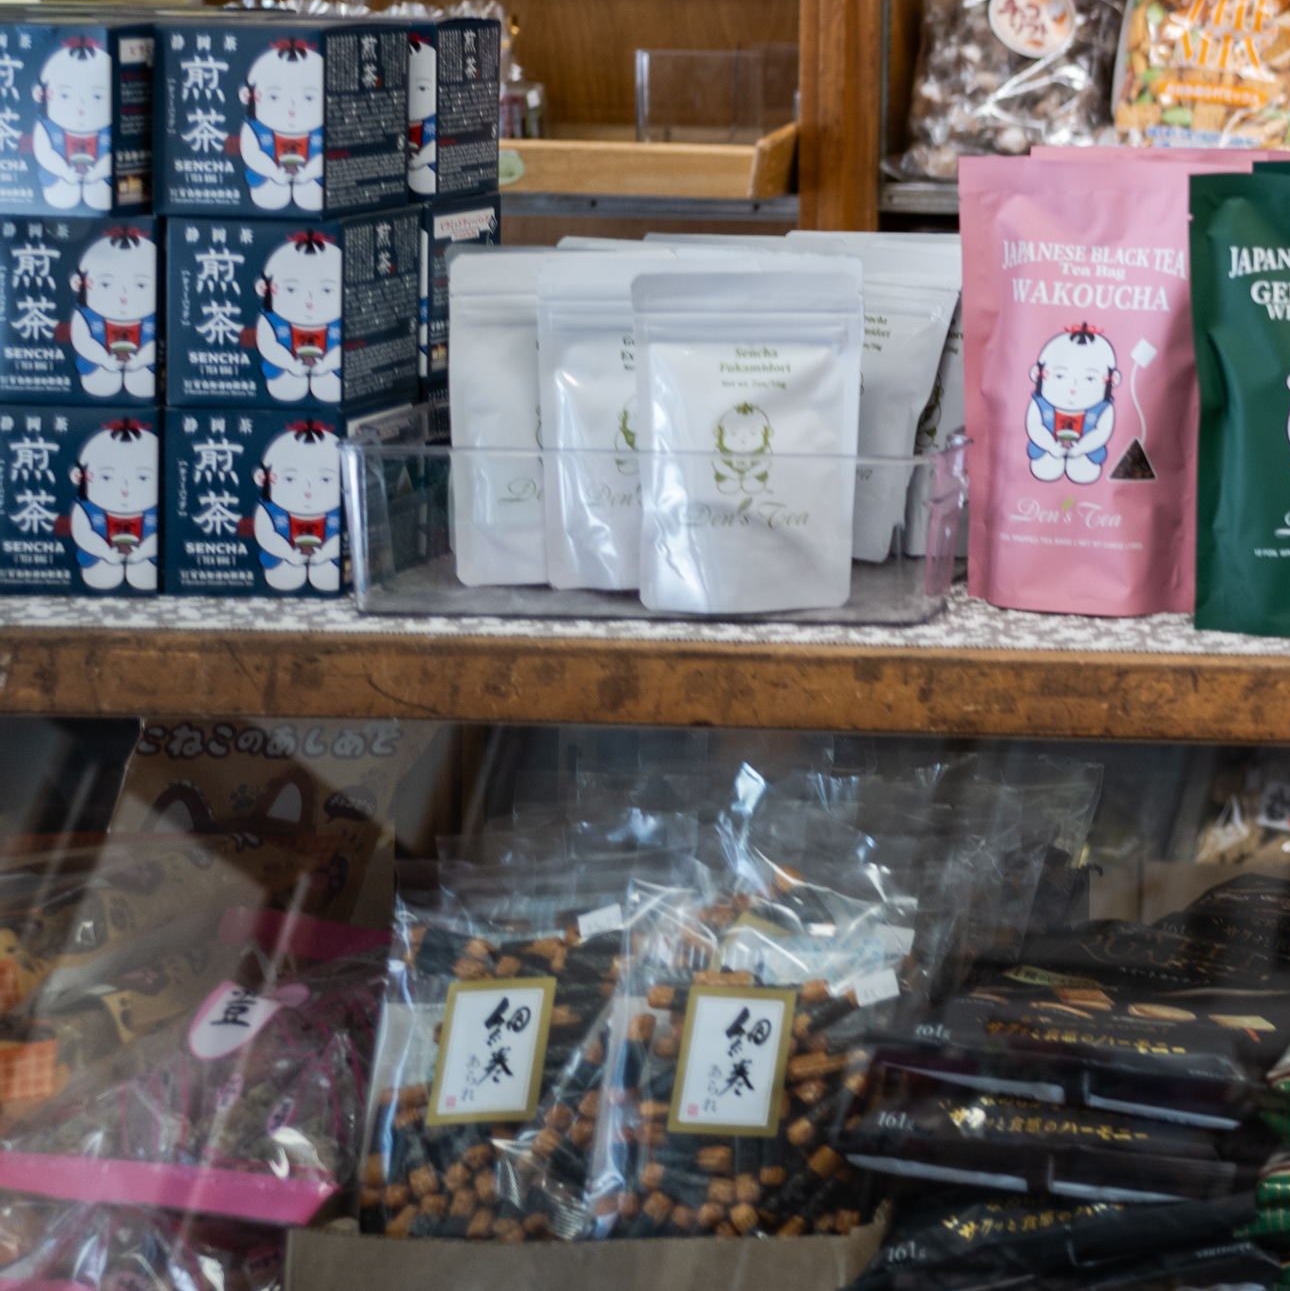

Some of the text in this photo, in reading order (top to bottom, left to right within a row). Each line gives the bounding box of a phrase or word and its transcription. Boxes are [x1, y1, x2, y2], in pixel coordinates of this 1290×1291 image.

[1169, 30, 1277, 82] MIX
[180, 55, 230, 153] 煎茶
[0, 159, 29, 172] CHA
[174, 160, 235, 173] SENCHA
[1002, 240, 1187, 280] JAPANESE BLACK TEA
[1059, 261, 1126, 281] Tea Bag
[10, 243, 61, 341] 煎茶
[195, 247, 246, 346] 煎茶
[1012, 278, 1171, 312] WAKOUCHA
[3, 347, 65, 360] SENCHA
[188, 352, 251, 365] SENCHA
[735, 346, 778, 358] Sencha
[719, 361, 791, 373] Fukamidori
[9, 436, 60, 534] 煎茶
[192, 438, 244, 536] 煎茶
[757, 501, 809, 529] Tea
[1010, 497, 1122, 529] Den's Tea
[2, 540, 65, 554] SENCHA
[185, 542, 248, 555] SENCHA
